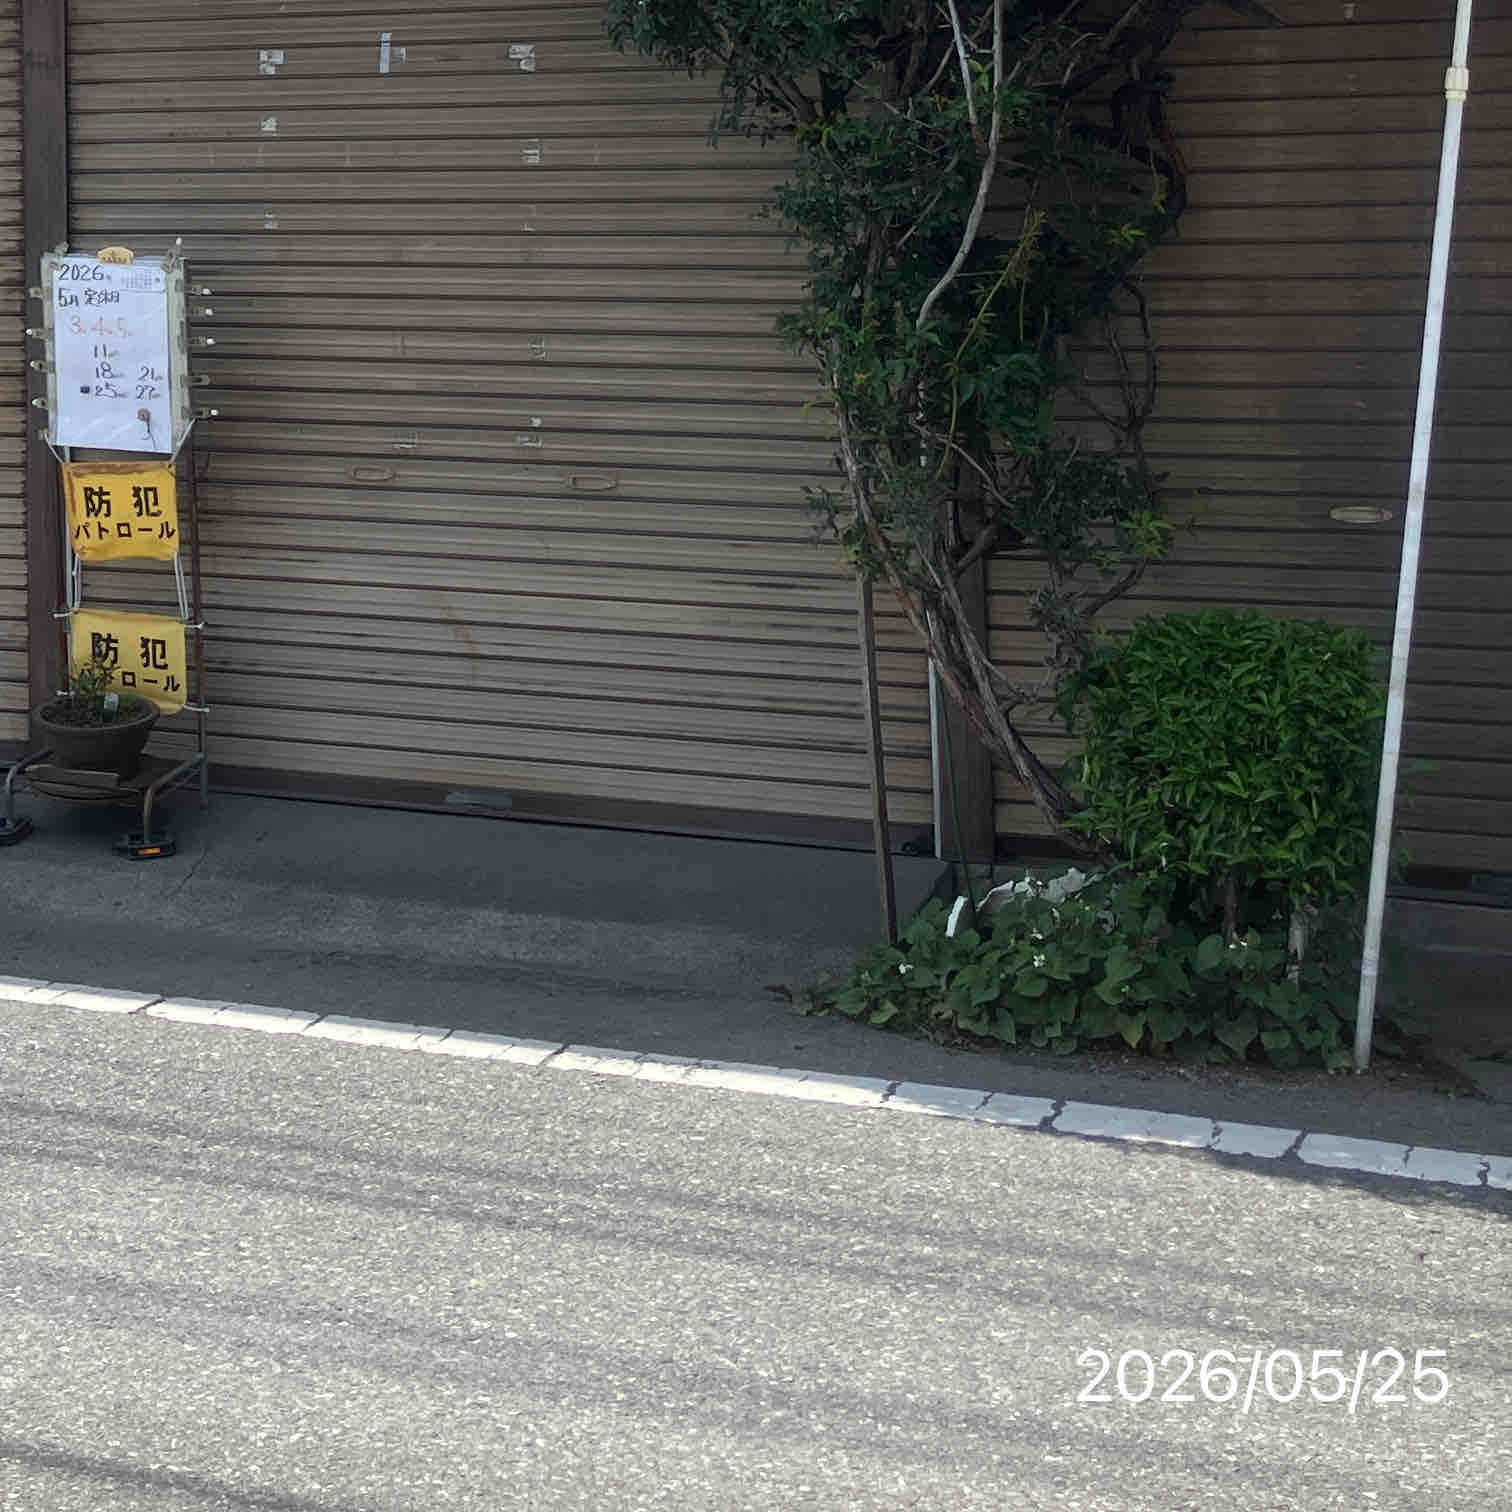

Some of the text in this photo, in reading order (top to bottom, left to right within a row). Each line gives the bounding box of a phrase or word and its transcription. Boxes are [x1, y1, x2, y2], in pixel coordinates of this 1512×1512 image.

[83, 486, 162, 518] 防犯
[74, 522, 176, 541] パトロール
[91, 632, 168, 670] 防犯
